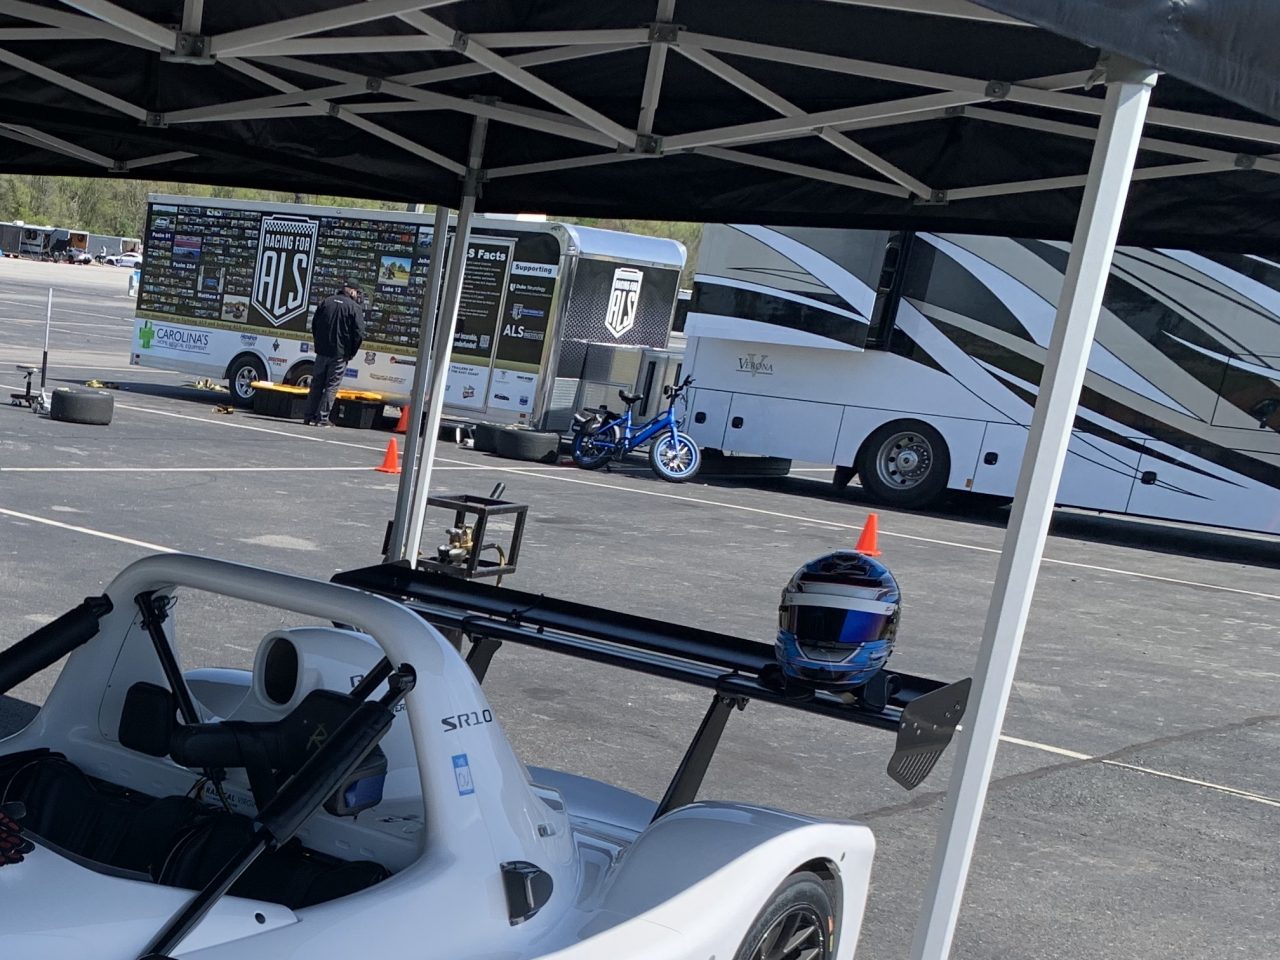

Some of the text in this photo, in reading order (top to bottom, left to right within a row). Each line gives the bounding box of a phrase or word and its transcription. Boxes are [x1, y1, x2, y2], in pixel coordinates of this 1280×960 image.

[264, 233, 311, 251] RACING FOR
[478, 249, 506, 261] Facts
[515, 264, 552, 274] Supporting
[257, 251, 308, 318] ALS
[609, 289, 636, 331] ALS
[157, 328, 209, 346] CAROLINA'S
[503, 324, 525, 338] ALS
[441, 708, 494, 733] SR10
